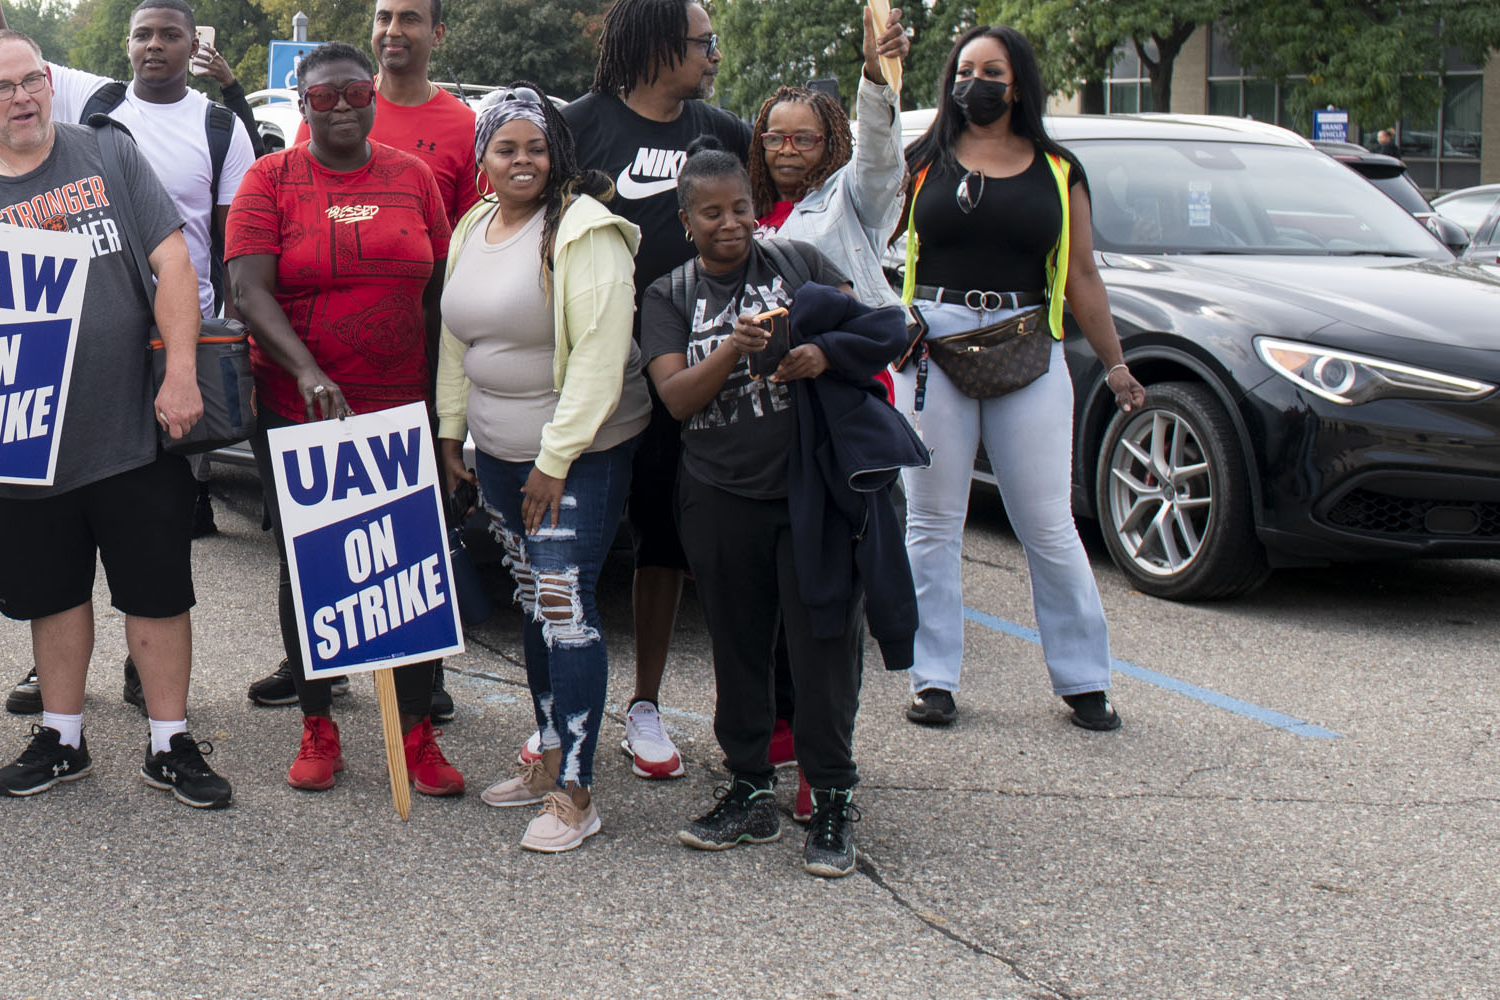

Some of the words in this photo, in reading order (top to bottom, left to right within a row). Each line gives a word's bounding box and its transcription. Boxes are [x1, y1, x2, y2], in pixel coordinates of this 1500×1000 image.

[631, 147, 687, 178] NIK
[325, 205, 379, 219] BLESSED
[691, 274, 794, 334] LACK
[282, 426, 421, 507] UAW
[344, 513, 398, 585] ON
[312, 553, 446, 661] STRIKE
